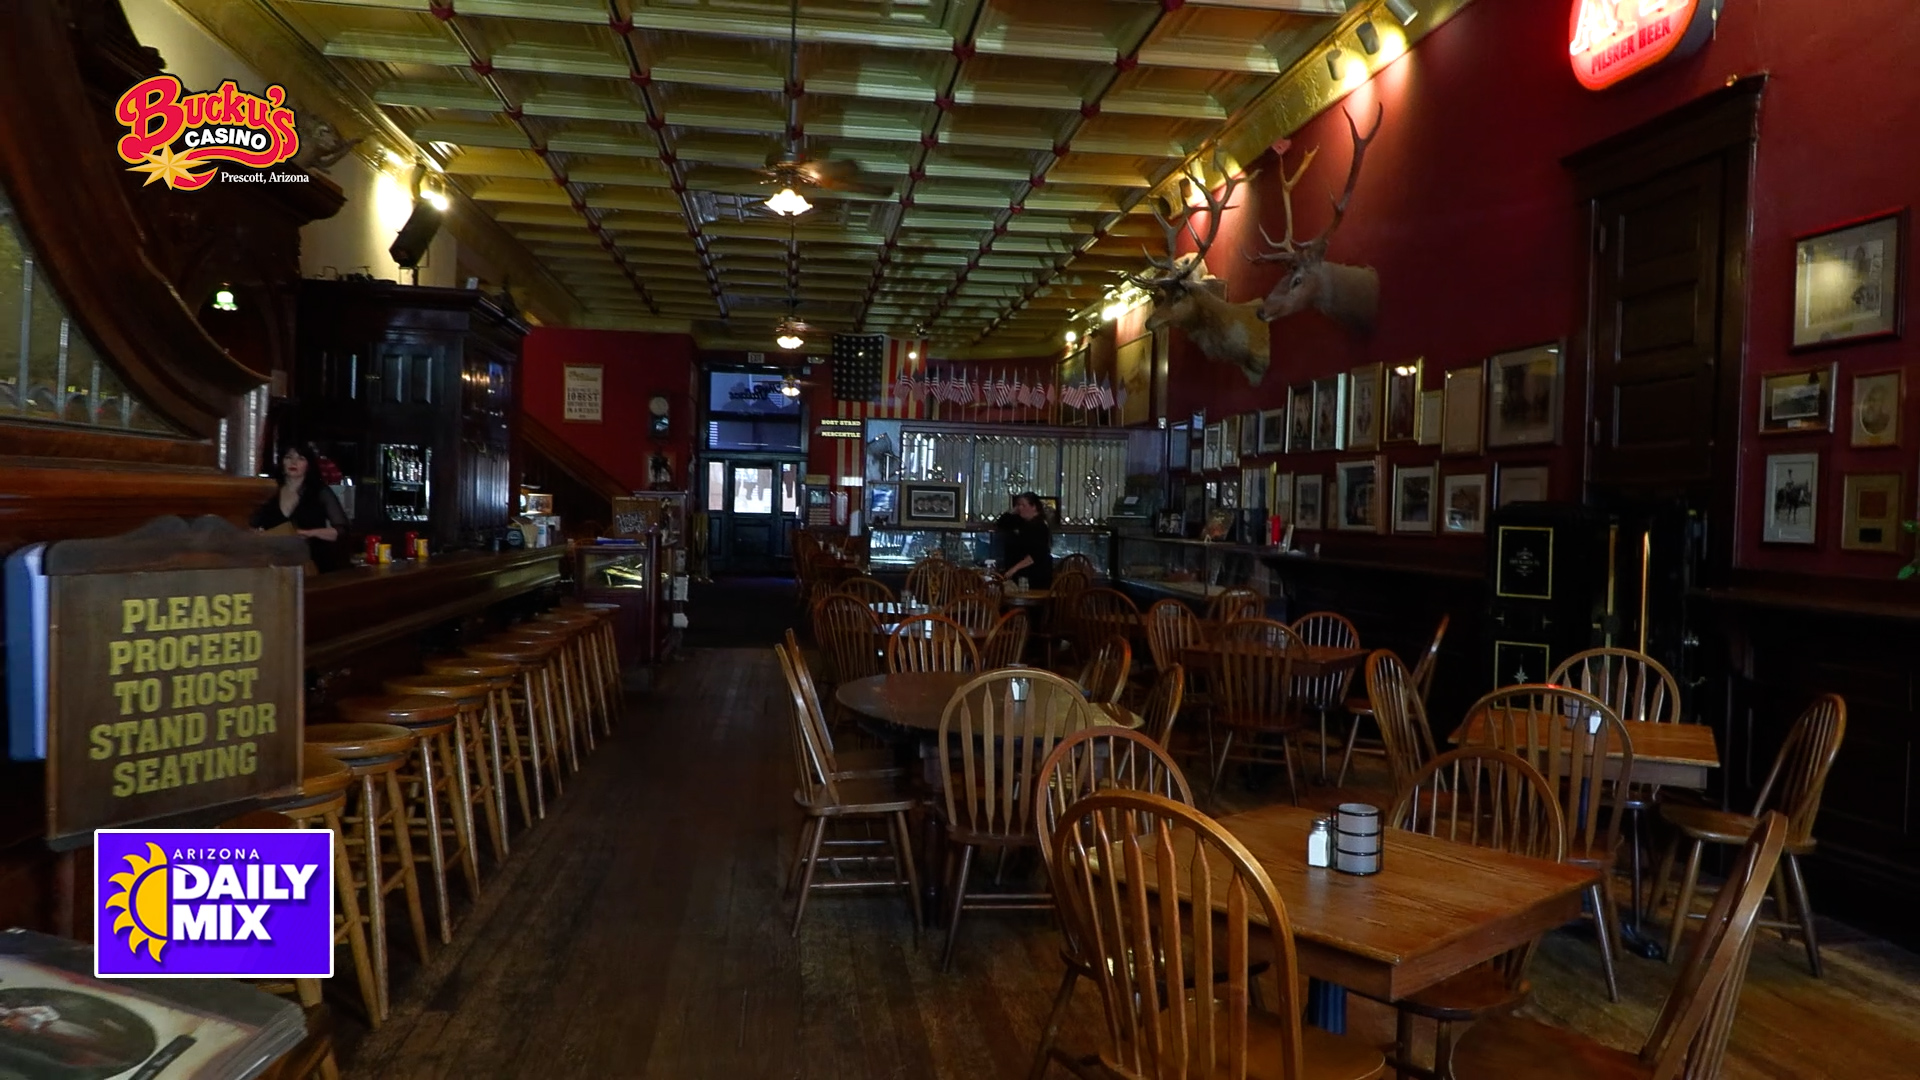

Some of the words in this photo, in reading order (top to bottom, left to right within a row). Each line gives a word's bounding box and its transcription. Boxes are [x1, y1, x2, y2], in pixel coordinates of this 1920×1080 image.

[1591, 34, 1635, 74] PILSNER
[1638, 16, 1671, 49] BEER
[577, 392, 600, 401] BEST
[122, 593, 254, 634] PLEASE
[109, 630, 263, 676] PROCEED
[113, 677, 162, 716] TO
[172, 667, 259, 709] HOST
[89, 712, 207, 760] STAND
[216, 702, 277, 741] FOR
[112, 742, 258, 798] SEATING
